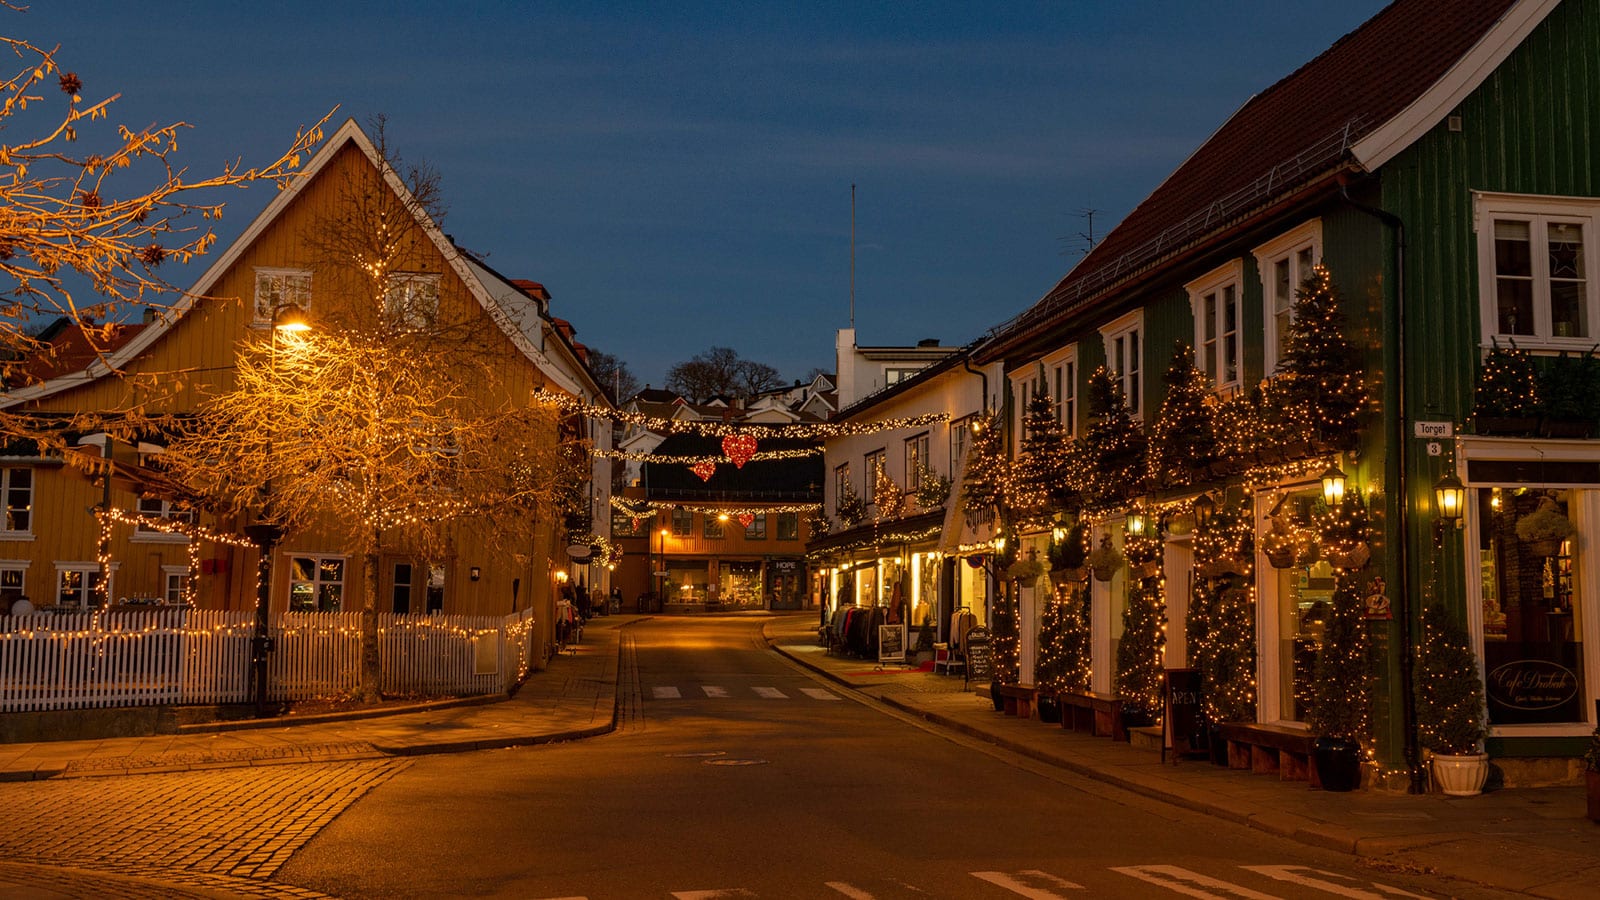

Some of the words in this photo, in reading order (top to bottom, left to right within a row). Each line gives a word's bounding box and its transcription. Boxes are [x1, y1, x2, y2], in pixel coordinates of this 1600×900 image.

[1421, 424, 1446, 435] Torget
[1431, 444, 1437, 453] 3
[776, 561, 796, 569] HOPE
